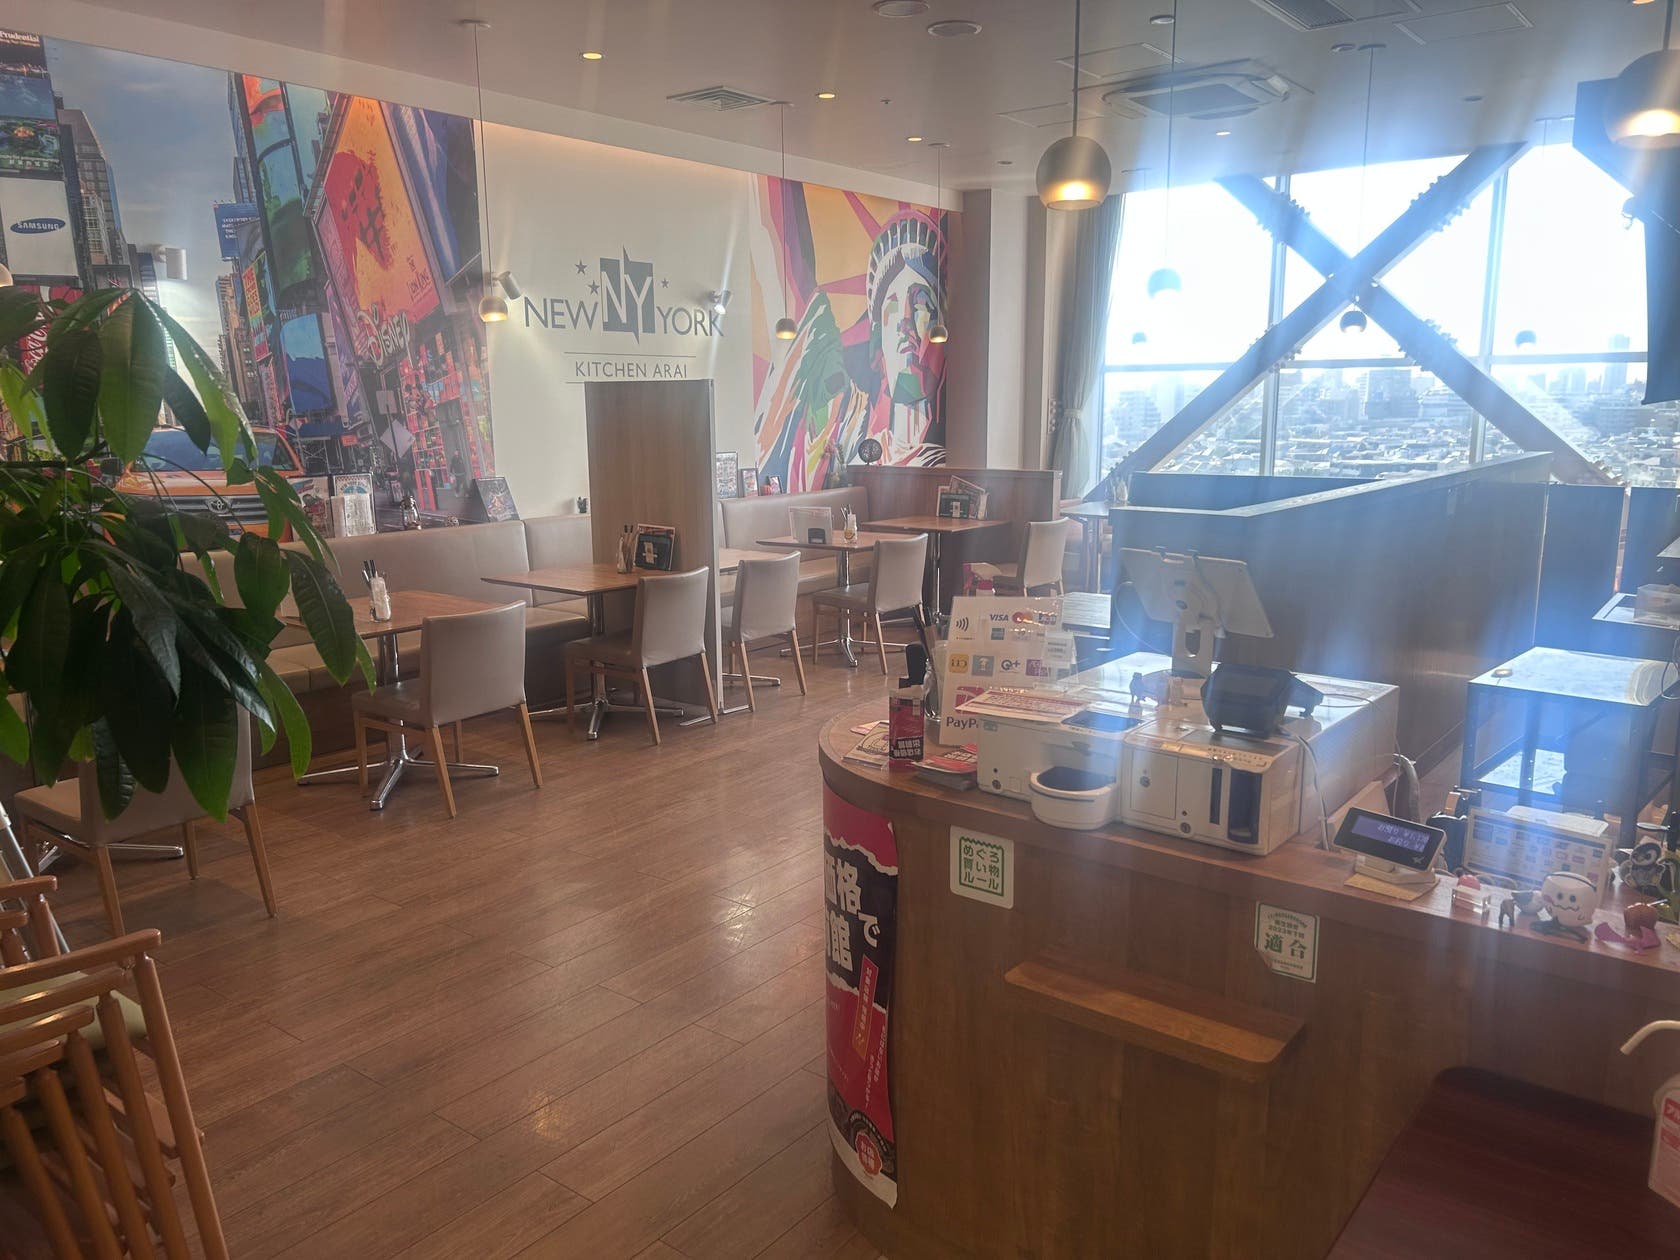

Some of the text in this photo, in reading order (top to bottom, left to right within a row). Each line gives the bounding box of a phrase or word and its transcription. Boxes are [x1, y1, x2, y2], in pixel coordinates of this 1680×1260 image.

[17, 221, 60, 230] SAMSUNG
[524, 252, 724, 338] NEW NY YORK
[575, 360, 688, 379] KITCHEN ARAI
[989, 613, 1009, 622] VISA
[946, 716, 979, 730] PayP
[963, 844, 1000, 864] めぐろ
[963, 858, 1000, 878] 買い物
[963, 871, 999, 891] ルール
